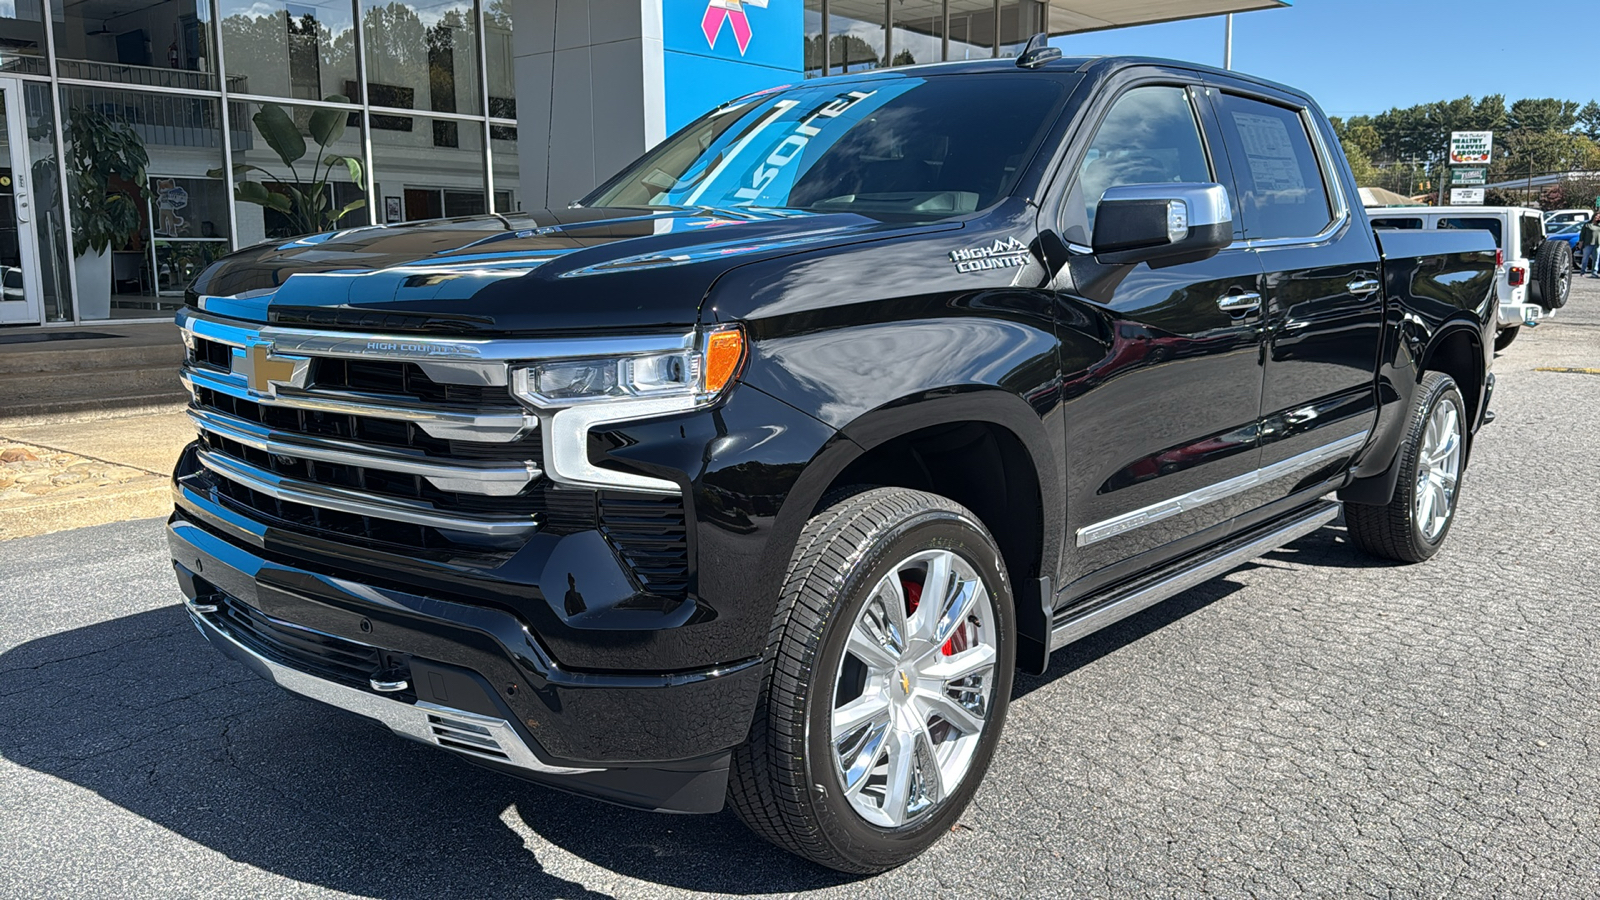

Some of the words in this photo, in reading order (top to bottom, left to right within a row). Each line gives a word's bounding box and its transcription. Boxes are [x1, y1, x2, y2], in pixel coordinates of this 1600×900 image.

[950, 246, 994, 262] HIGH
[956, 254, 1031, 273] COUNTRY
[367, 342, 397, 351] HIGH
[400, 343, 460, 353] COUNTRY
